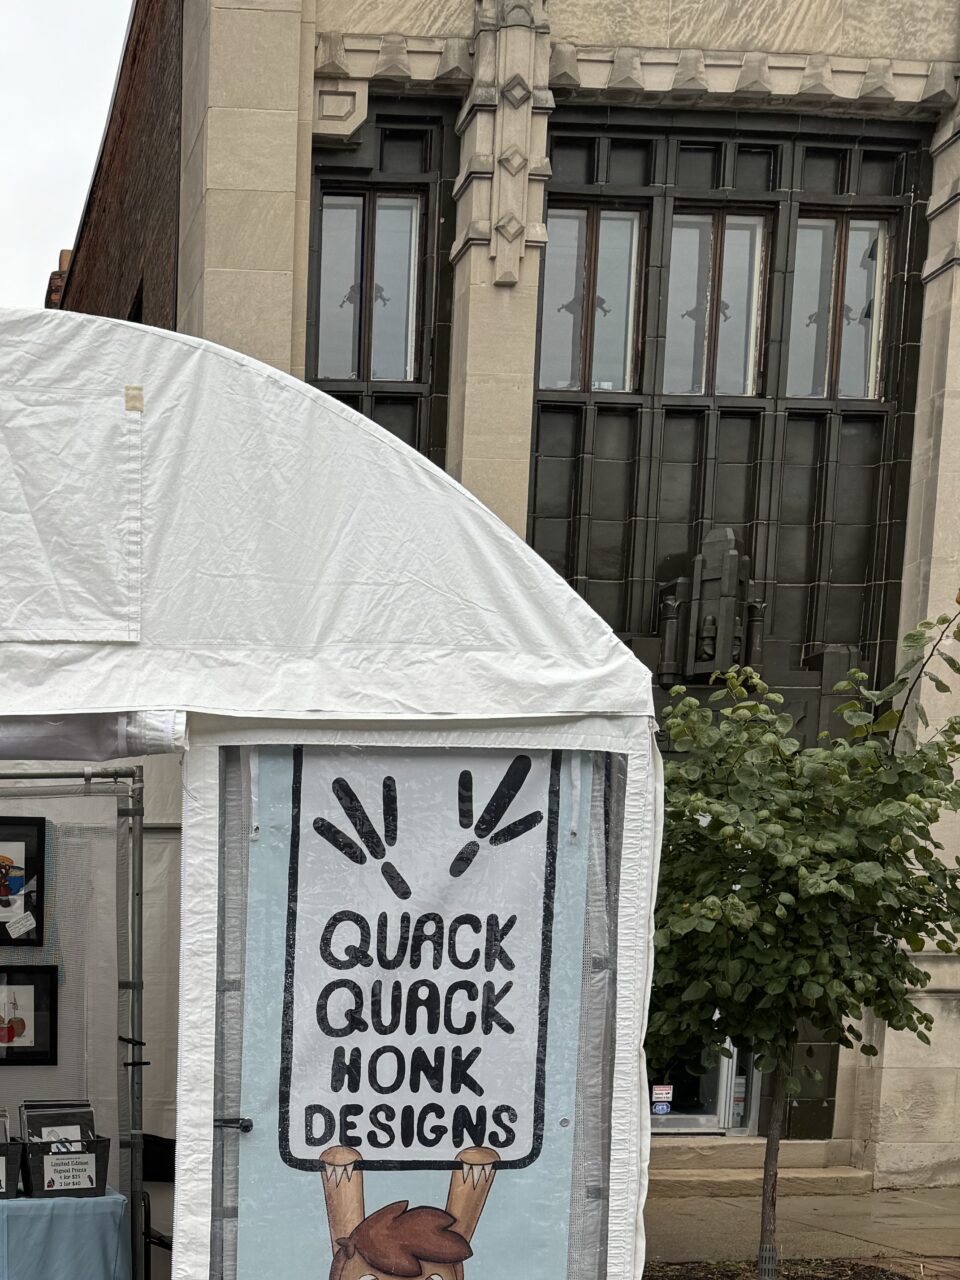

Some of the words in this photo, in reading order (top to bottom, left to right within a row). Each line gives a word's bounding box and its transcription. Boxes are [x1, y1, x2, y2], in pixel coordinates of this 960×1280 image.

[320, 910, 517, 972] QUACK
[316, 978, 515, 1037] QUACK
[331, 1045, 484, 1097] HONK
[304, 1103, 518, 1149] DESIGNS
